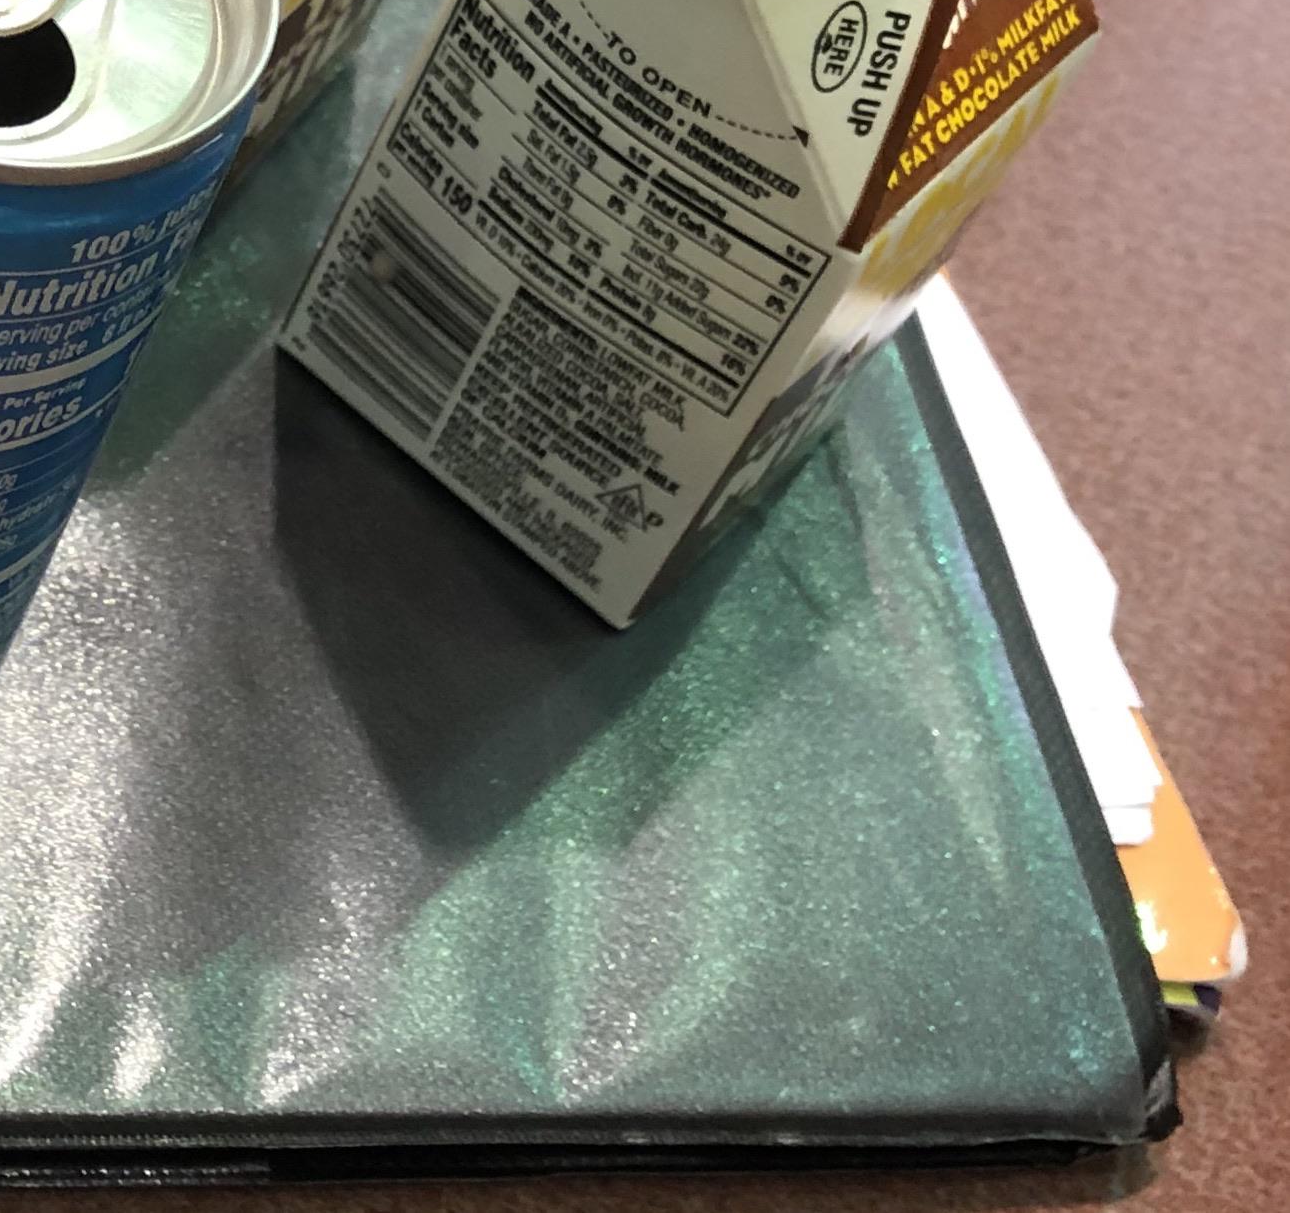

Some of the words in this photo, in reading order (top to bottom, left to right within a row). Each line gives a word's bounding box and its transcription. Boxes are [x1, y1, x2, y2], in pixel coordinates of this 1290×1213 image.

[450, 15, 497, 79] Facts
[823, 17, 860, 76] HERE
[861, 9, 912, 93] PUSH
[607, 31, 637, 66] TO
[641, 67, 712, 118] OPEN
[898, 132, 936, 177] FAT
[935, 41, 1041, 145] CHOCOLATE
[1041, 4, 1082, 53] MILK
[847, 98, 881, 138] UP
[71, 221, 157, 264] 100%
[64, 312, 98, 340] per
[46, 338, 88, 366] size
[4, 396, 28, 409] Per
